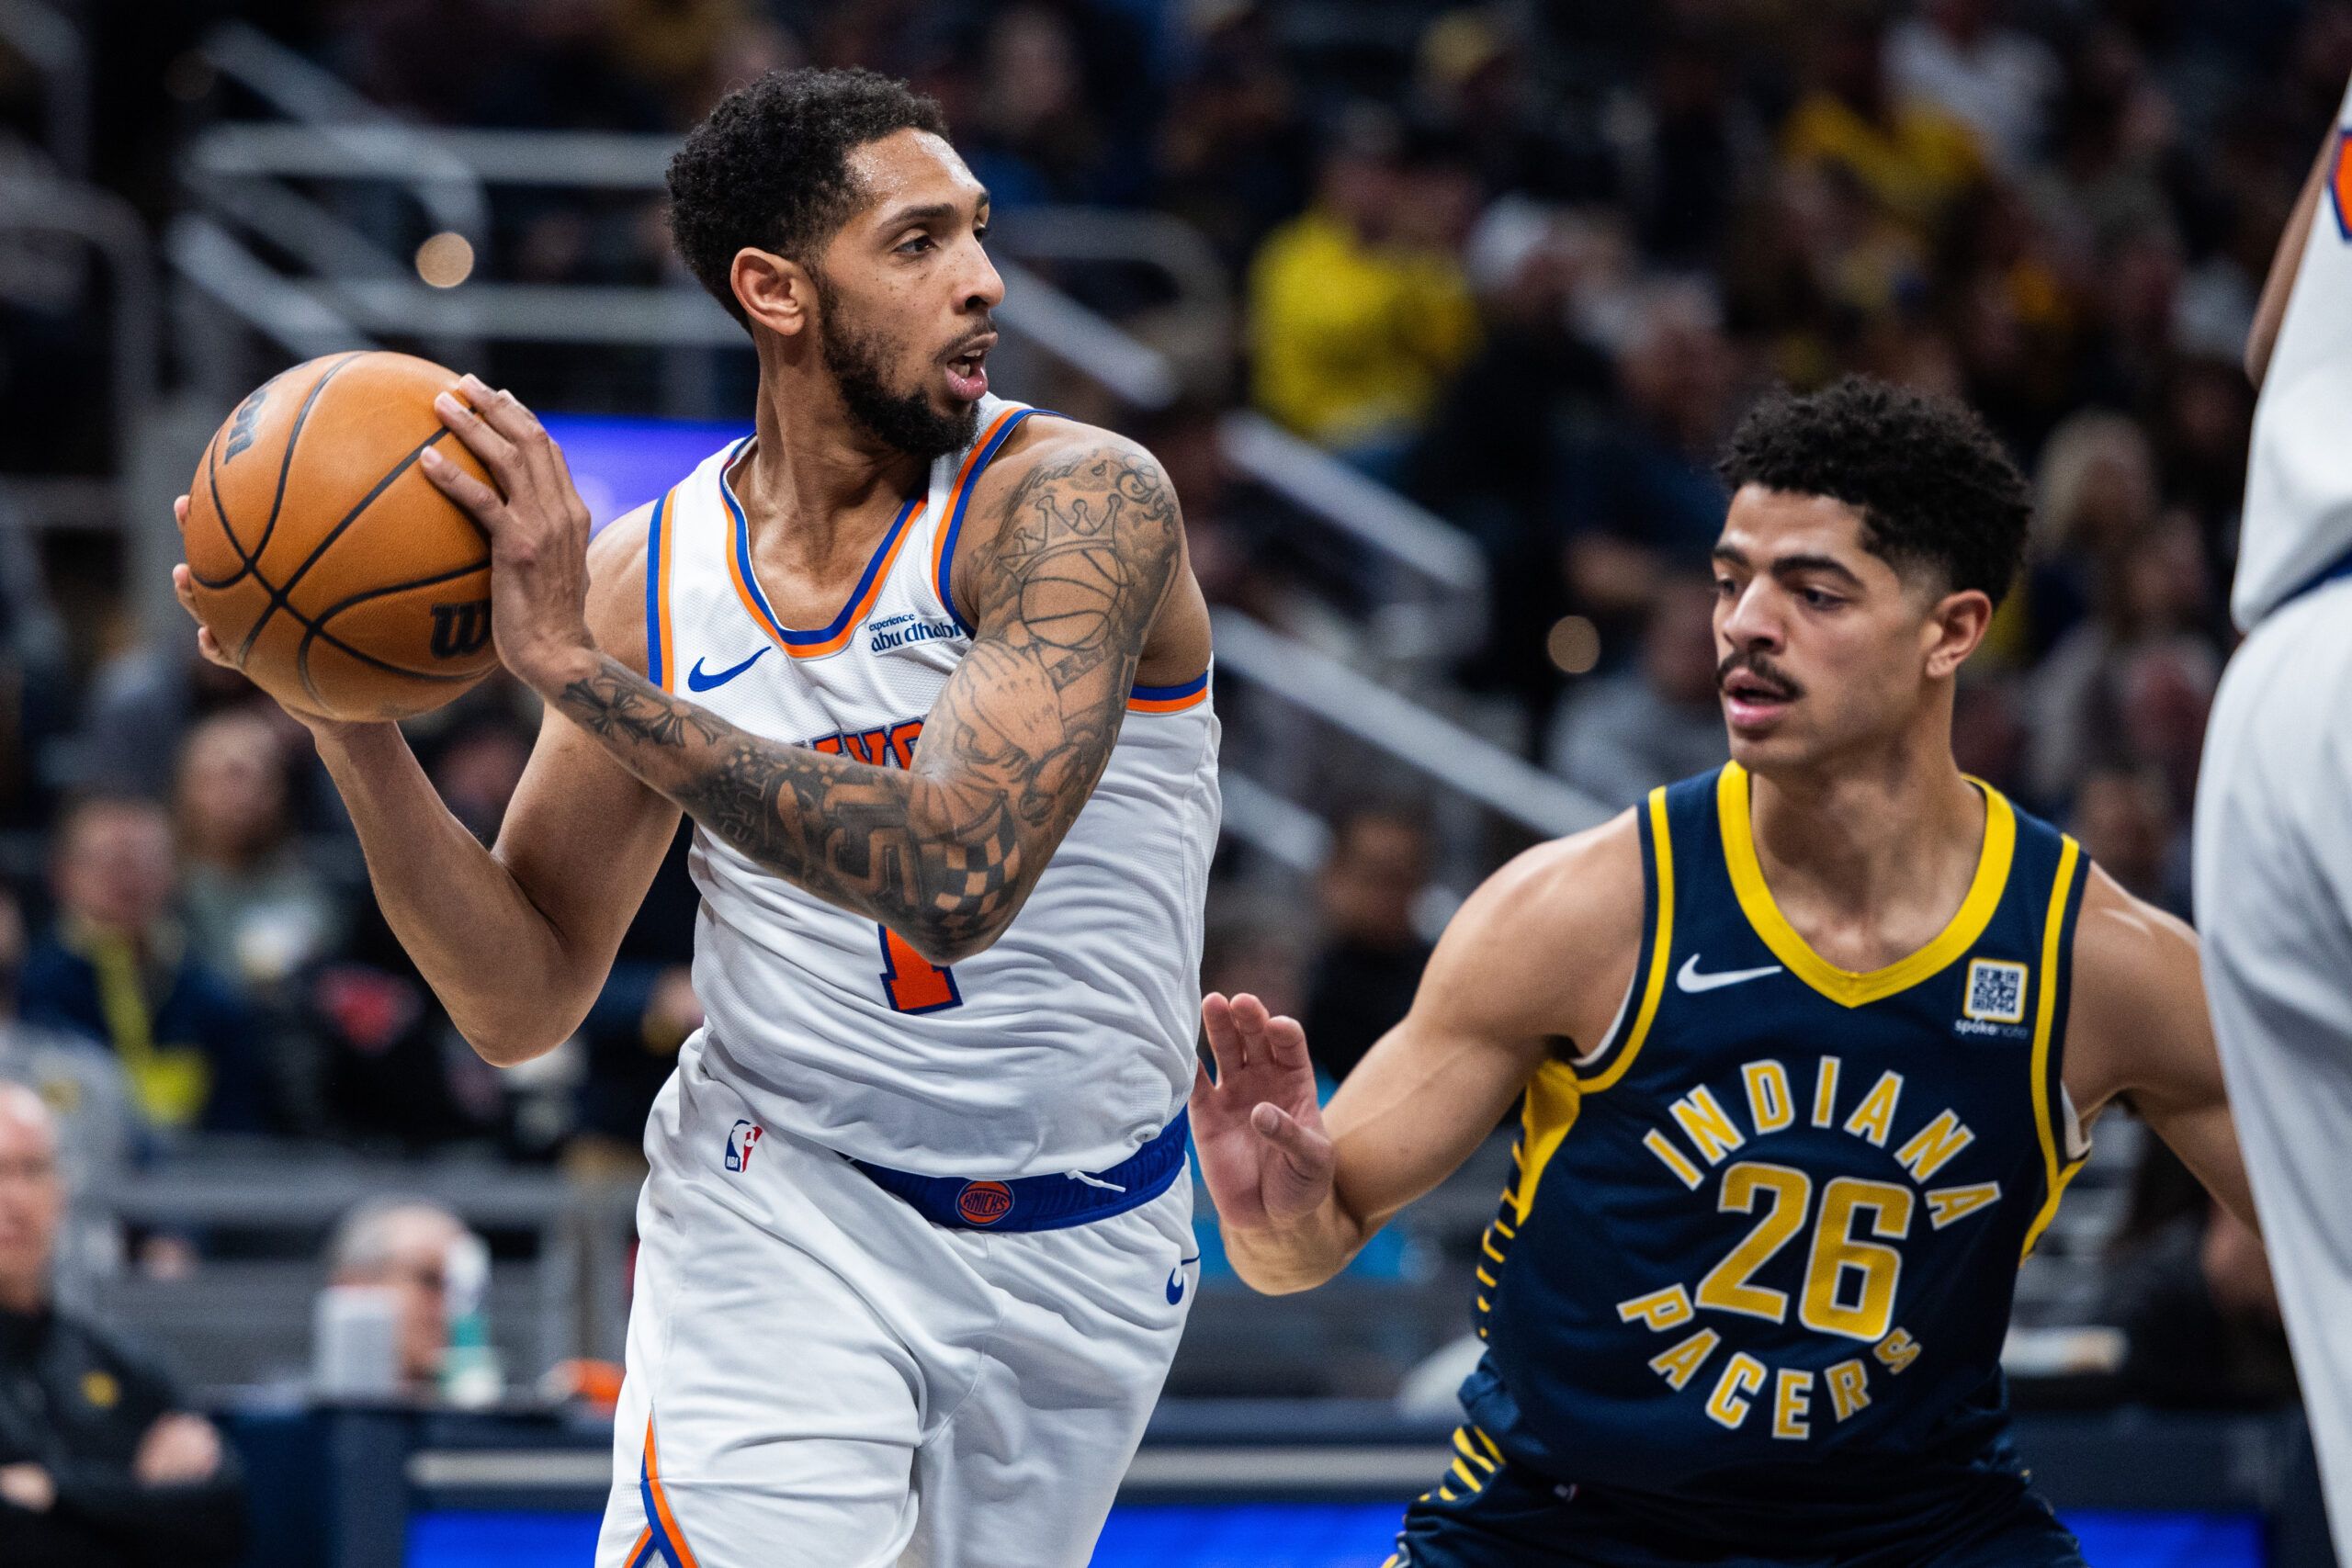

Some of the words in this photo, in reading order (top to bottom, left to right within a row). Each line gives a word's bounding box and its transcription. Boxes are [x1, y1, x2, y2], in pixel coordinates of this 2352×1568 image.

[869, 613, 915, 631] experience
[871, 630, 903, 652] abu
[904, 621, 962, 643] dhabi
[1643, 1055, 2001, 1230] INDIANA
[963, 1191, 1008, 1213] KNICKS
[1694, 1160, 1915, 1342] 26
[1616, 1283, 1922, 1439] PACERS
